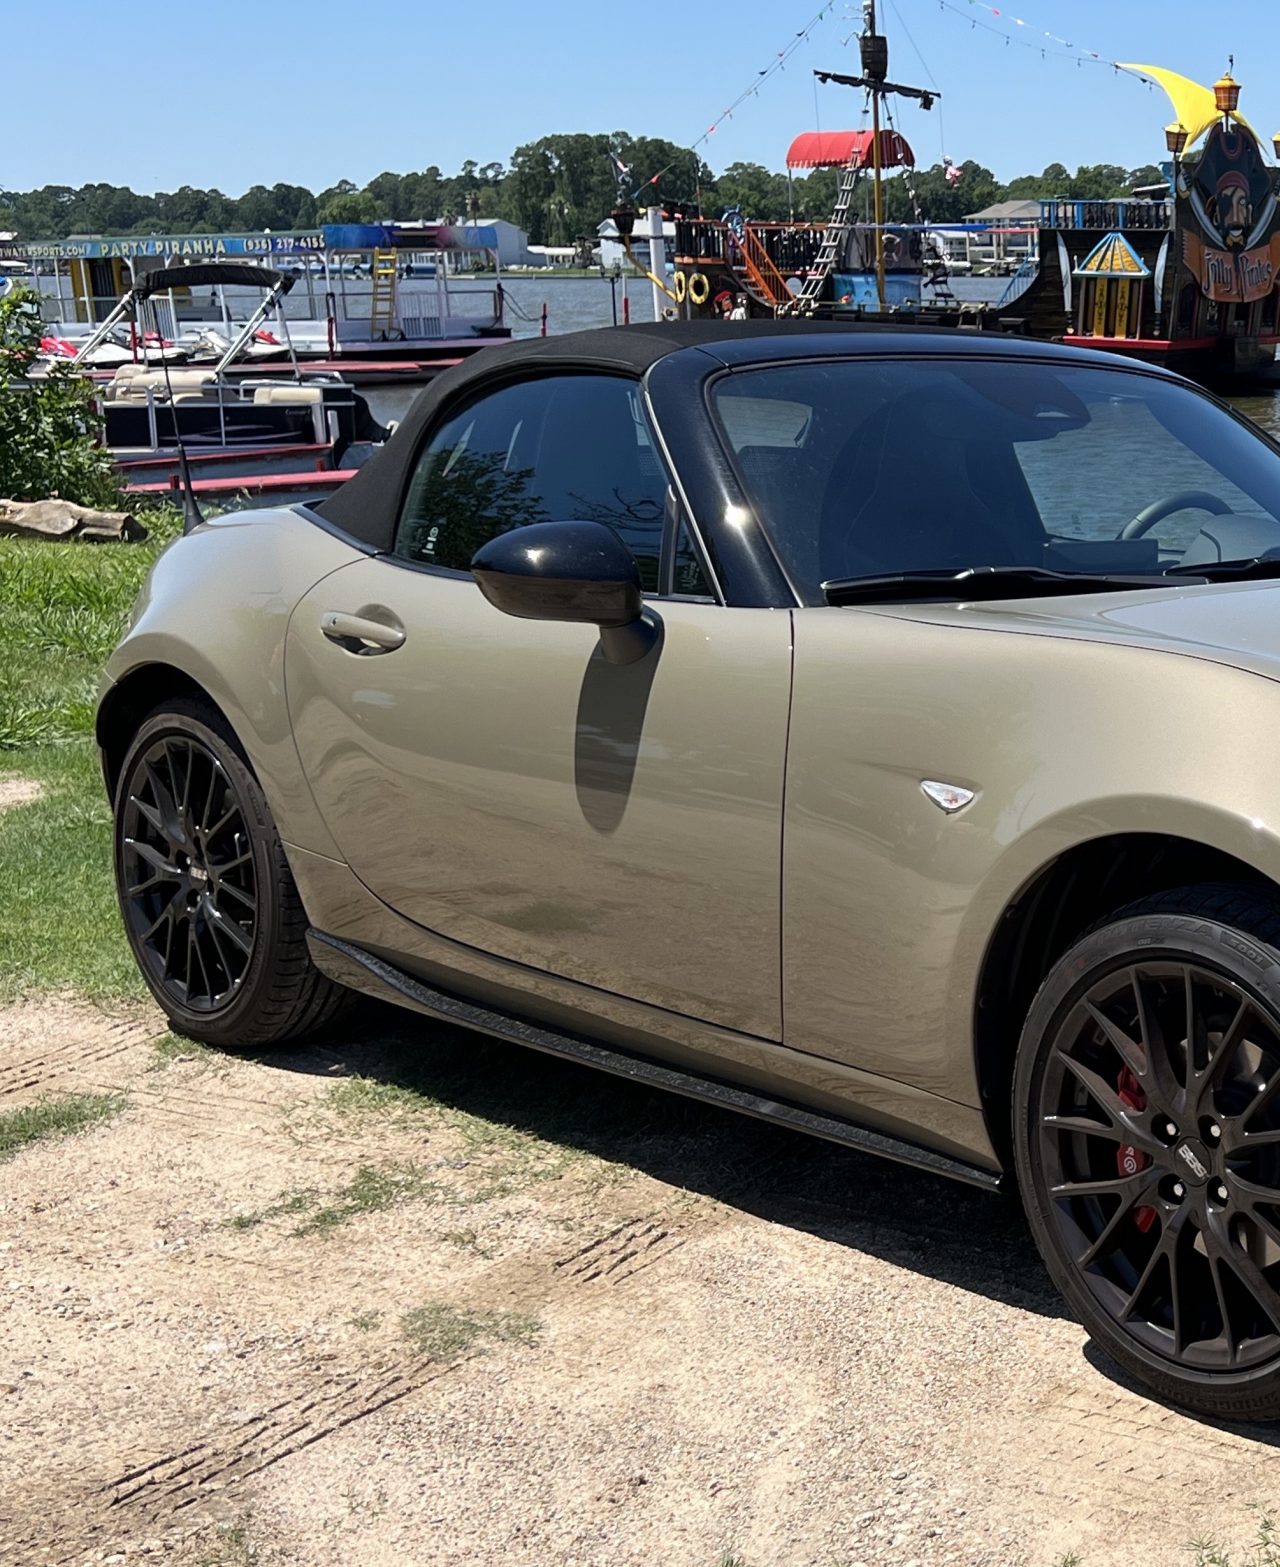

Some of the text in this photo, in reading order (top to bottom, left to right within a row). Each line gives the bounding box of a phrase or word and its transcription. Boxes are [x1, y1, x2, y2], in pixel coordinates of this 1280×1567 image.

[101, 241, 148, 256] PARTY
[155, 239, 226, 255] PIRANHA
[243, 238, 272, 252] (936)
[1178, 1144, 1208, 1178] BBS
